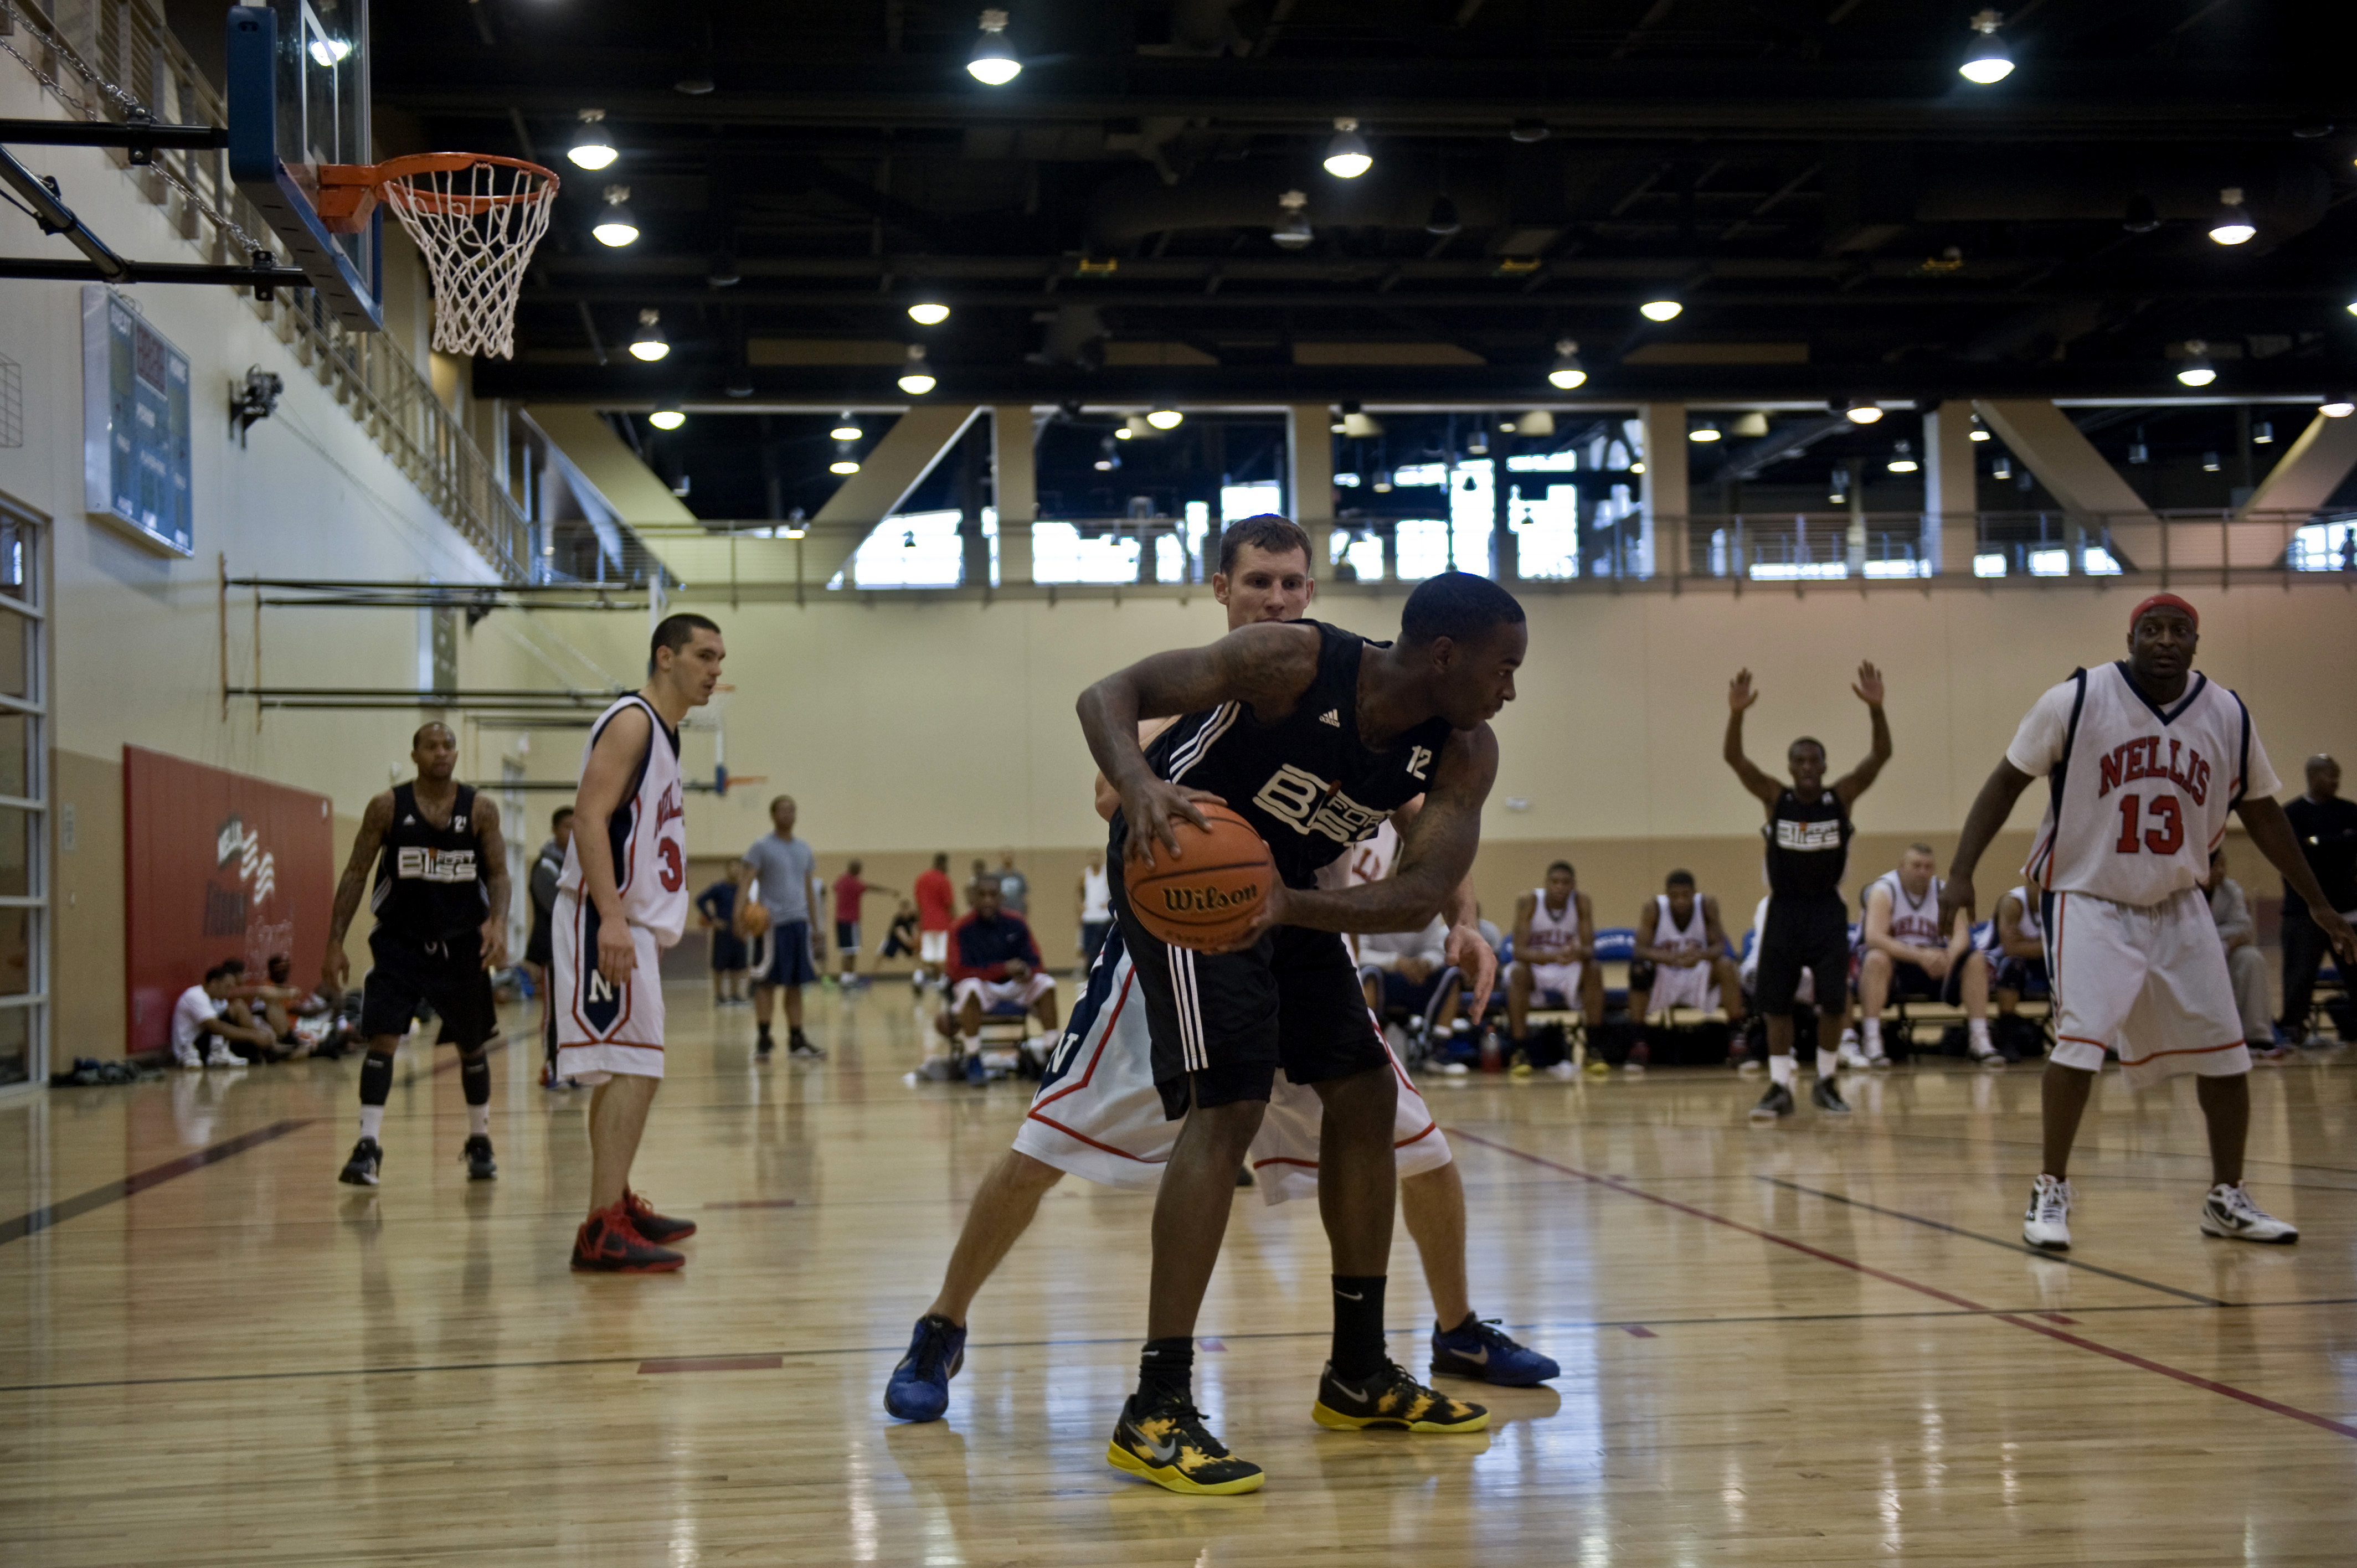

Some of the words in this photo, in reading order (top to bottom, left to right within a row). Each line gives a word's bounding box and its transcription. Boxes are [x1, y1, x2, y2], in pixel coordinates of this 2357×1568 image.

[1406, 745, 1432, 780] 12
[2099, 735, 2210, 806] NELLIS
[2116, 794, 2184, 854] 13
[658, 835, 688, 892] 3
[1162, 883, 1258, 912] Wilson
[588, 968, 614, 1003] N
